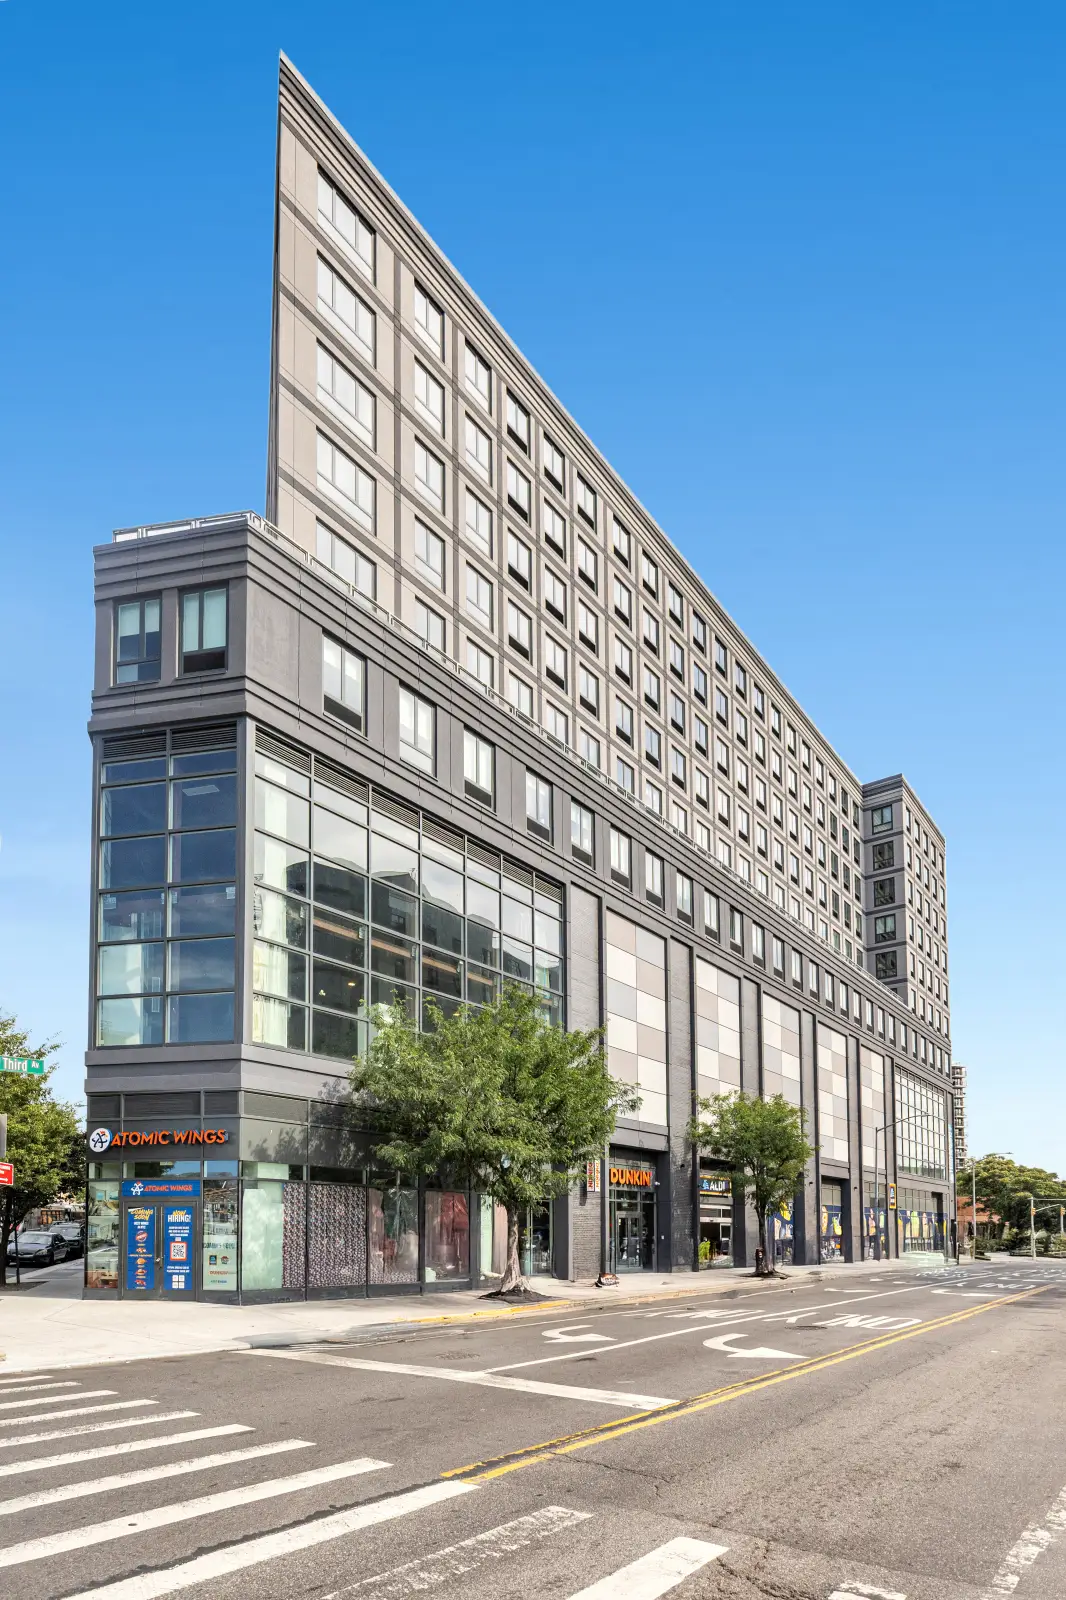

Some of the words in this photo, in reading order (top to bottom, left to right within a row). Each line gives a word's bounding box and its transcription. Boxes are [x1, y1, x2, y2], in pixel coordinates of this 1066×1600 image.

[2, 1057, 28, 1072] Third
[31, 1060, 40, 1069] Av
[111, 1130, 171, 1146] ATOMIC
[174, 1129, 226, 1145] WINGS
[611, 1168, 653, 1187] DUNKIN'
[170, 1184, 192, 1192] WINGS
[710, 1181, 726, 1191] ALDI
